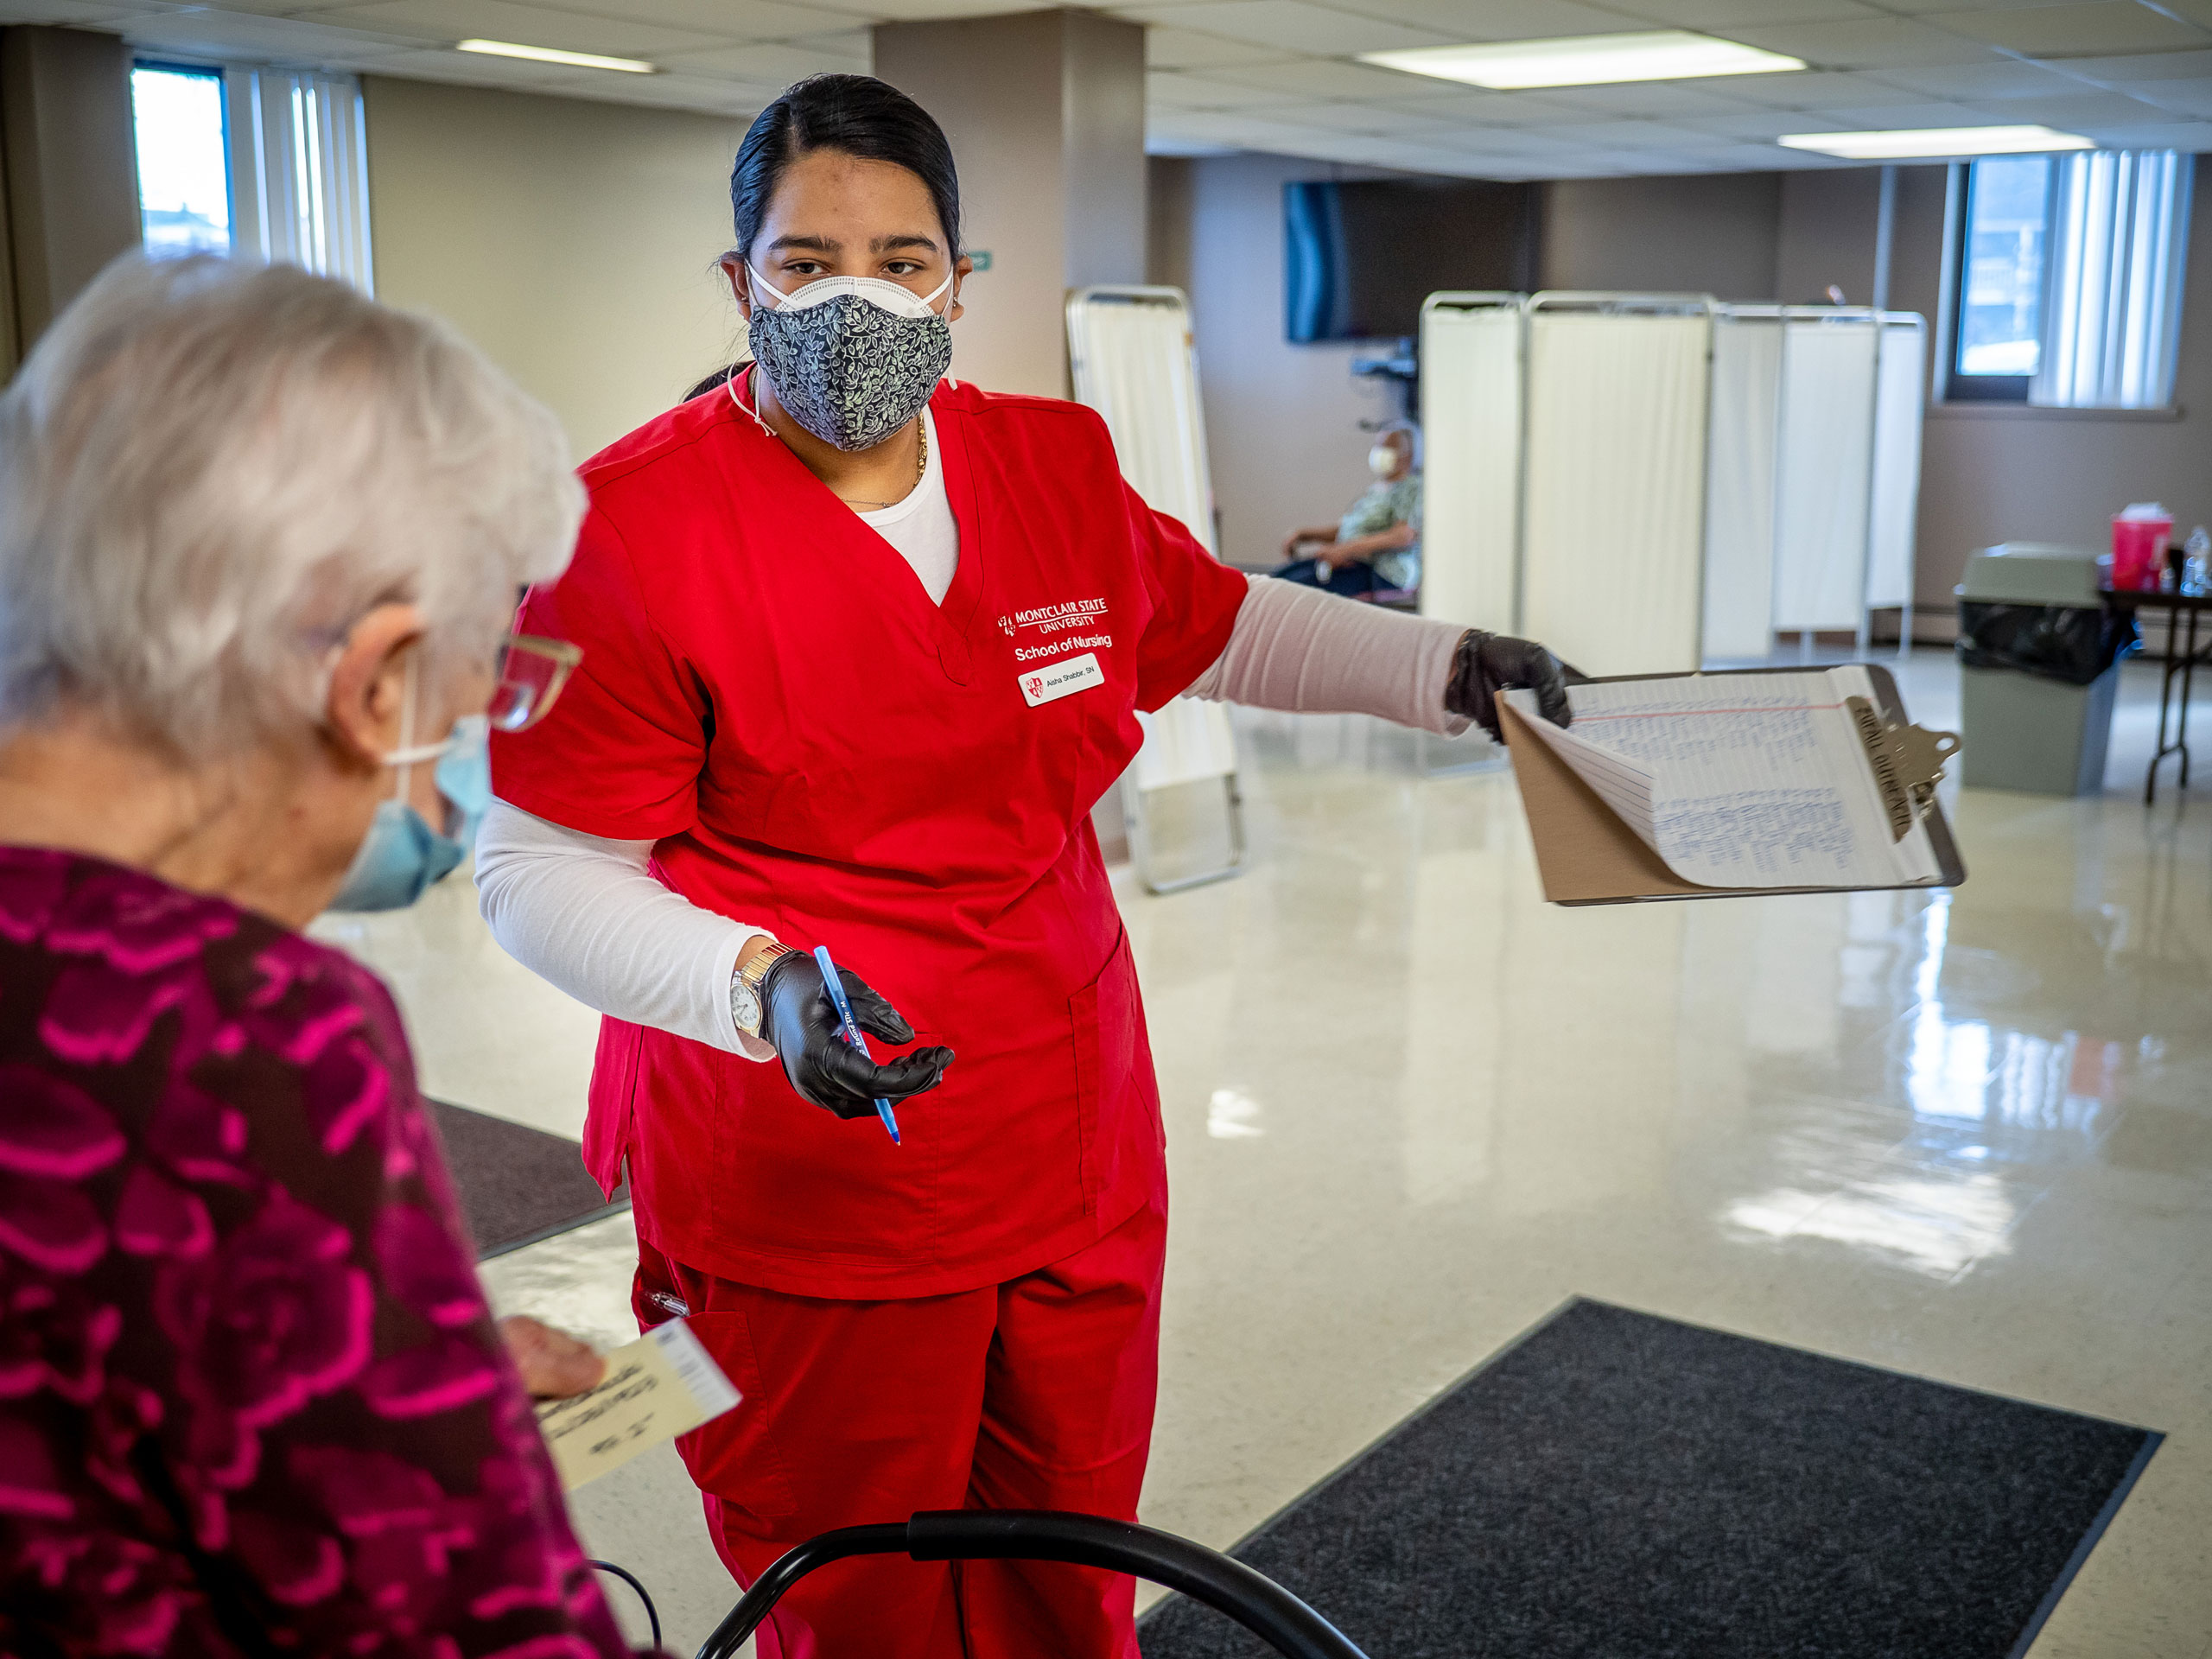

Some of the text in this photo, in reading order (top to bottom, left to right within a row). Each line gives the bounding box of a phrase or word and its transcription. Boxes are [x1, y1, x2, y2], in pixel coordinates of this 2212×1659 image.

[1015, 598, 1107, 623] MONTCLAIR STATE
[1039, 615, 1095, 634] UNIVERSITY
[1014, 634, 1112, 661] School of Nursing
[1046, 677, 1063, 687] Aisha
